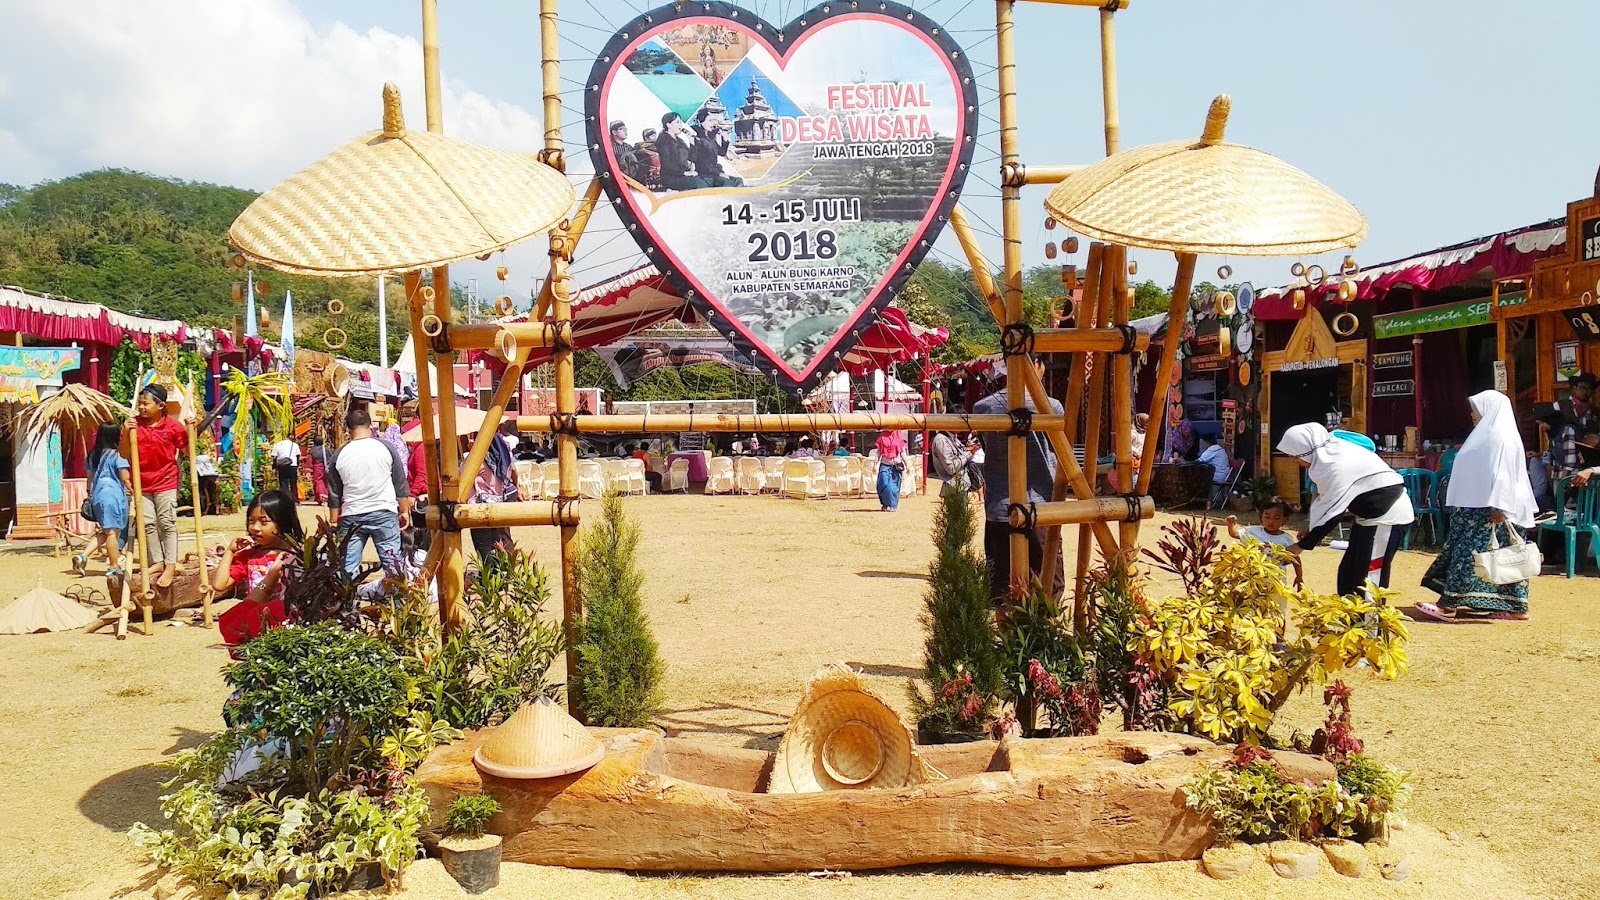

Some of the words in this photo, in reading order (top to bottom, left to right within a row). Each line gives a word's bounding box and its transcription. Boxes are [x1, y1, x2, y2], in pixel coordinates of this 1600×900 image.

[828, 83, 931, 110] FESTIVAL
[781, 118, 843, 142] DESA
[849, 114, 933, 141] WISATA
[814, 146, 850, 159] JAWA
[851, 144, 898, 158] TENGAH
[901, 143, 933, 156] 2018
[722, 203, 753, 225] 14
[774, 202, 805, 223] 15
[811, 199, 861, 222] JULI
[747, 230, 838, 262] 2018
[726, 271, 753, 281] ALUN
[761, 270, 787, 280] ALUN
[789, 268, 817, 279] BUNG
[820, 267, 854, 277] KARNO
[733, 283, 791, 294] KABUPATEN
[793, 280, 849, 291] SEMARANG
[1386, 319, 1412, 330] desa
[1417, 309, 1462, 323] wisata
[1378, 354, 1410, 366] KAMPUNG
[1376, 383, 1407, 393] KURCACI
